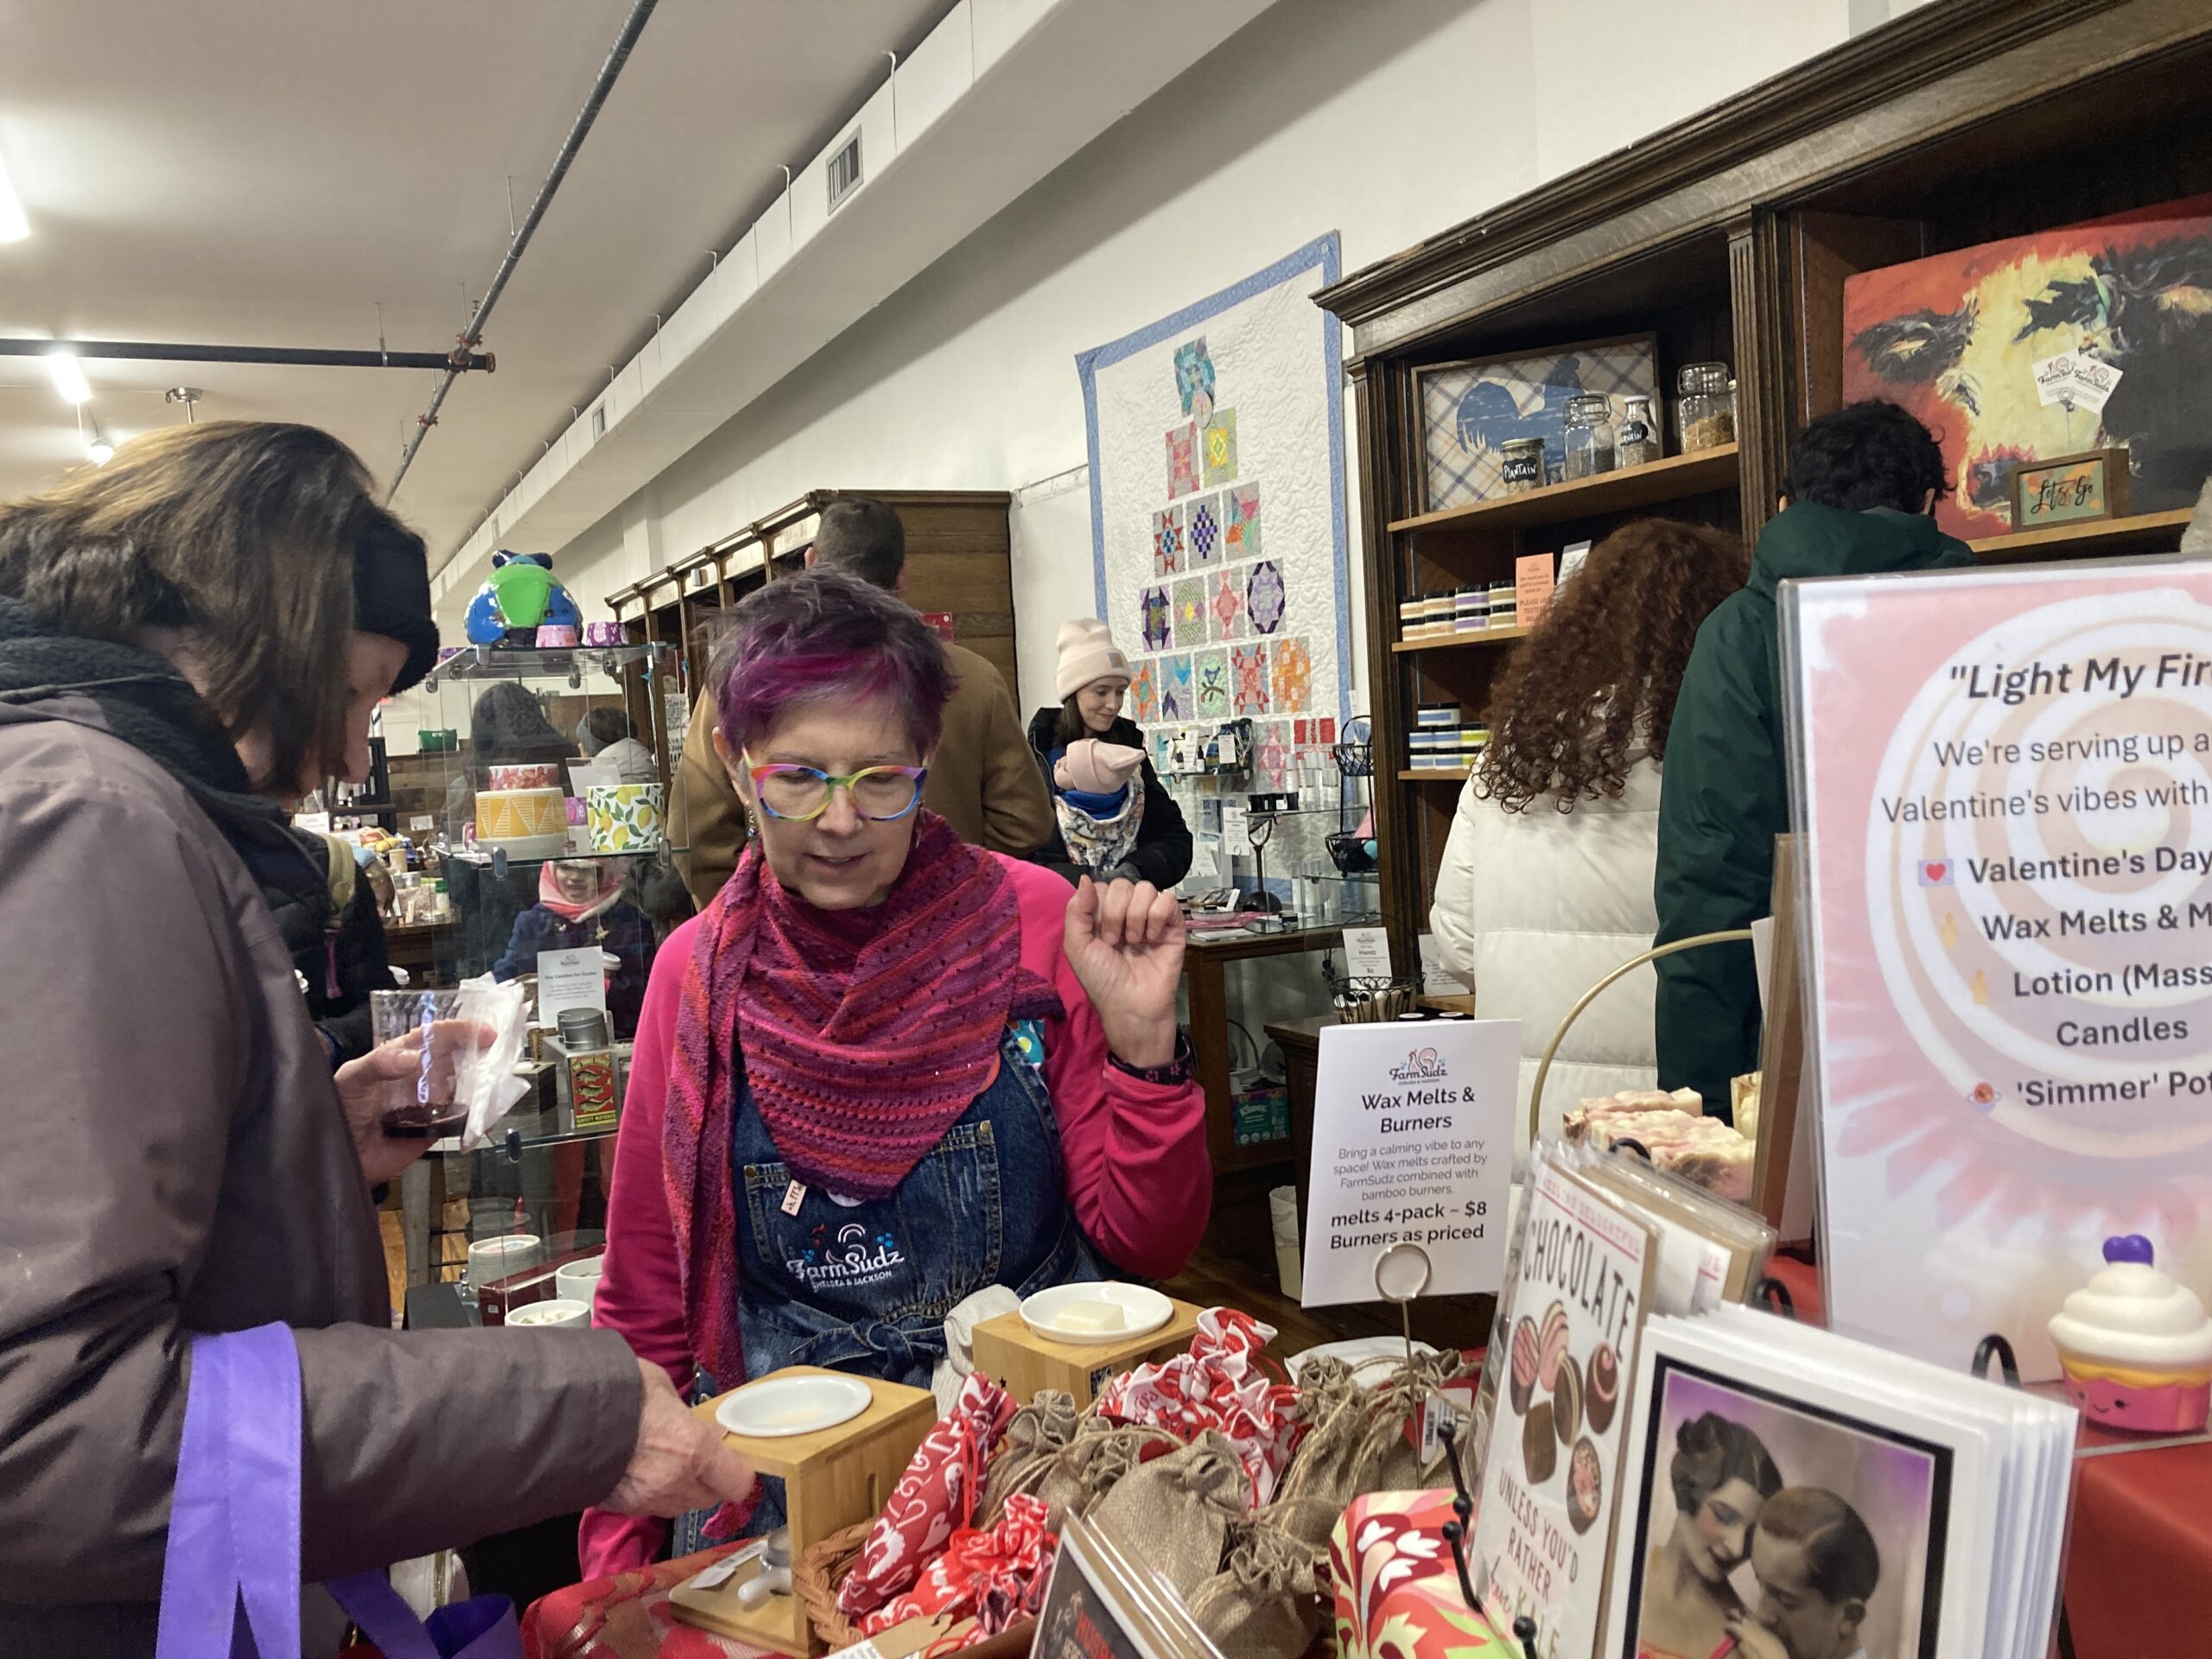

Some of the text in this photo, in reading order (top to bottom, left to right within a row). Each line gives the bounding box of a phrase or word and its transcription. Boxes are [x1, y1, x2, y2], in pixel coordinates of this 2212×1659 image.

[1949, 654, 2212, 706] "Light My Fir
[1935, 739, 2022, 767] We're
[2031, 733, 2139, 765] serving
[2148, 735, 2184, 760] up
[1882, 780, 2209, 823] Valentine's vibes with
[1967, 847, 2212, 884] Valentine's Day
[1981, 914, 2051, 943] Wax
[2059, 907, 2148, 938] Melts
[2157, 905, 2179, 930] &
[2013, 963, 2212, 998] Lotion (Mass
[2057, 1015, 2189, 1047] Candles
[1389, 1065, 1447, 1080] FarmSudz
[1362, 1086, 1475, 1110] Wax Melts &
[2017, 1077, 2159, 1108] 'Simmer'
[1381, 1116, 1452, 1134] Burners
[1333, 1152, 1488, 1175] space! Wax melts crafted by
[1338, 1139, 1484, 1160] Bring a calming vibe to any
[1340, 1167, 1478, 1189] FarmSudz combined with
[1362, 1185, 1454, 1202] bamboo burners.
[1331, 1210, 1380, 1227] melts
[1384, 1203, 1446, 1224] 4-pack
[1464, 1200, 1487, 1217] $8
[1331, 1231, 1398, 1250] Burners
[1402, 1230, 1423, 1243] as
[1427, 1224, 1484, 1244] priced
[785, 1245, 905, 1282] FarmSudz
[854, 1270, 893, 1287] JACKSON
[1524, 1218, 1636, 1363] CHOCOLATE
[1499, 1467, 1579, 1584] UNLESS YOU'D
[1507, 1527, 1552, 1605] RATHER
